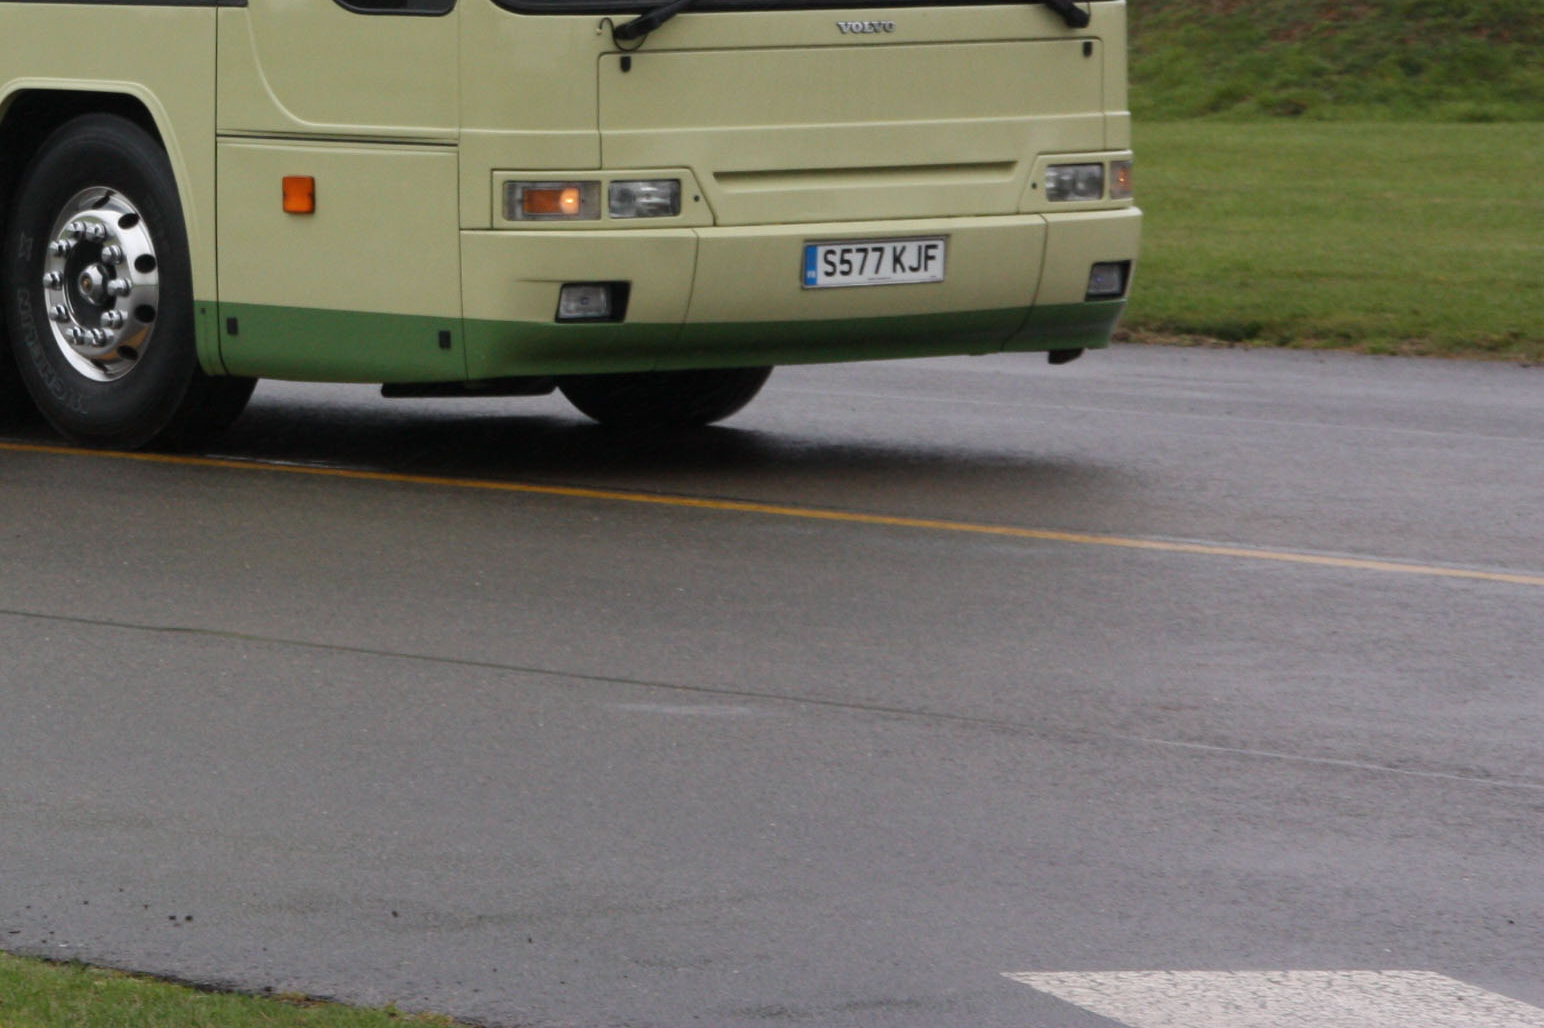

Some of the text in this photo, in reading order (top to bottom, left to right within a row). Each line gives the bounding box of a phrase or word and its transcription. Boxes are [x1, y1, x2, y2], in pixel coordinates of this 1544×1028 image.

[836, 19, 897, 35] VOLVO
[823, 243, 939, 278] S577 KJF
